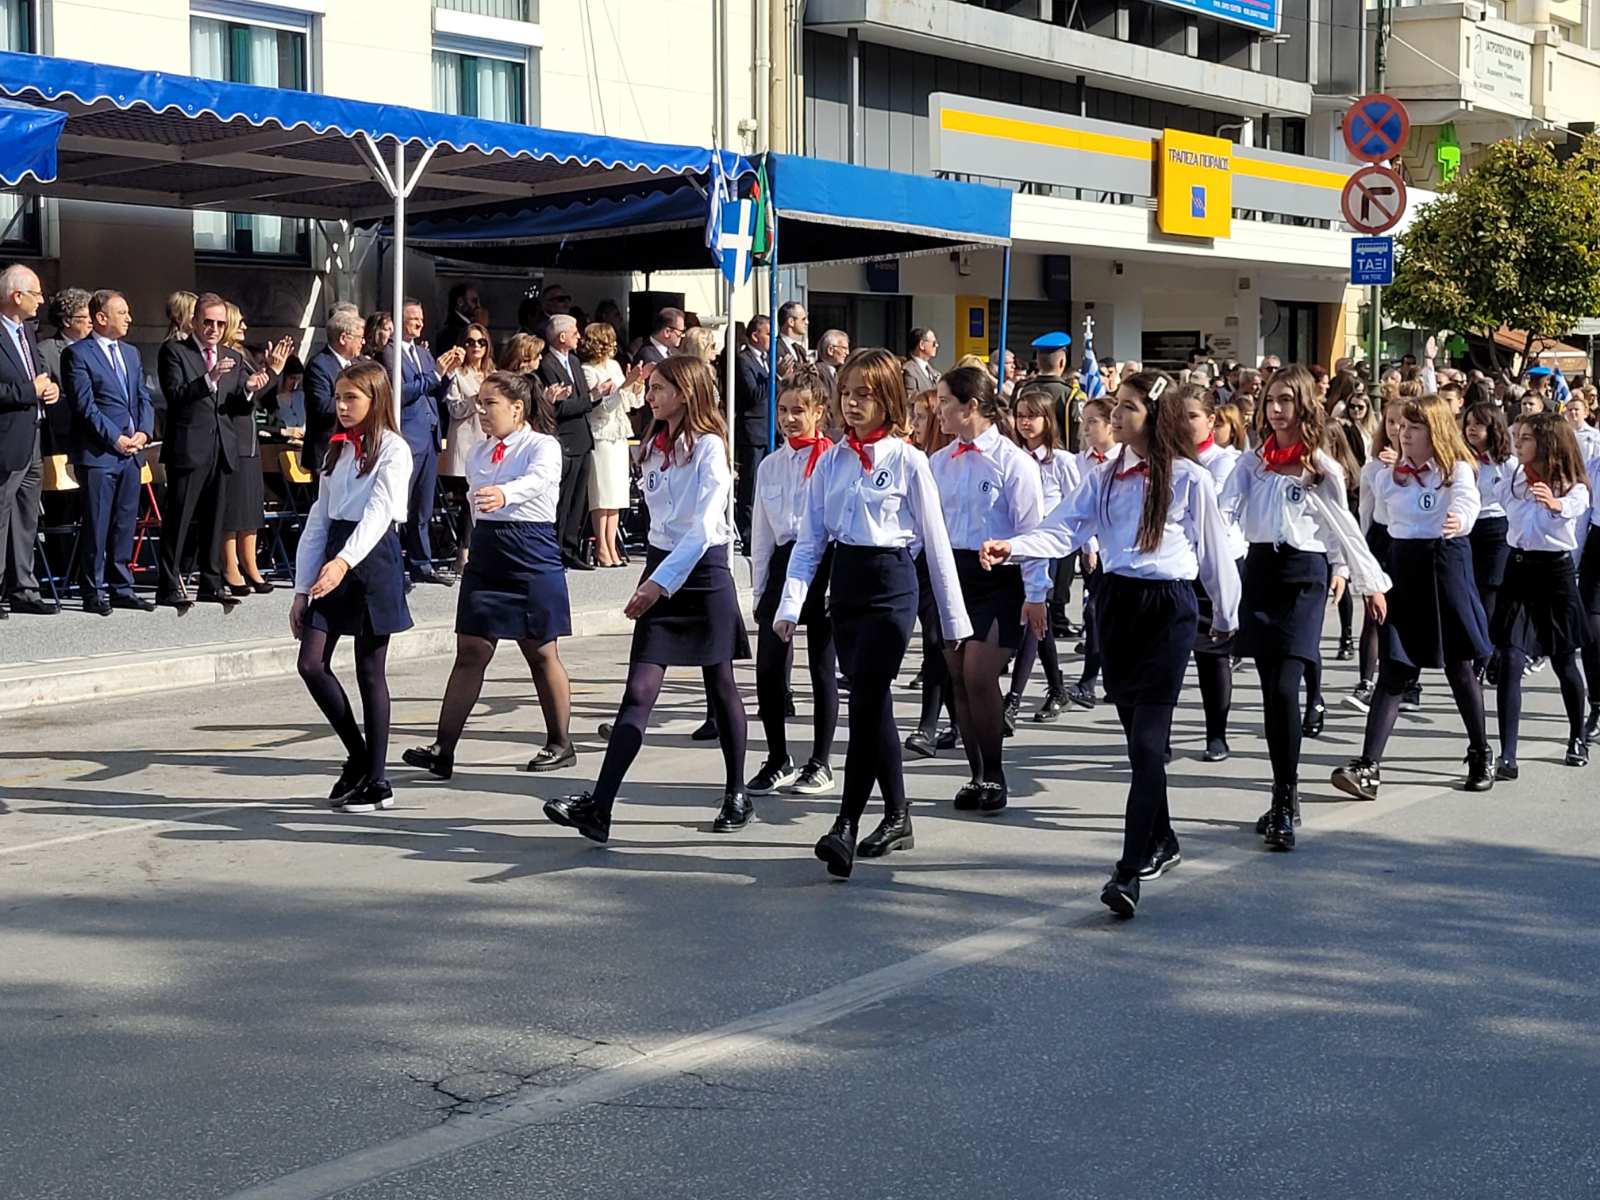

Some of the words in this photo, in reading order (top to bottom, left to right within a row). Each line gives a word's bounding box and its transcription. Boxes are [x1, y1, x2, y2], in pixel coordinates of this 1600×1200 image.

[1168, 148, 1198, 166] ΤΡΑΠΕΖΑ
[1357, 258, 1387, 270] ΤΑΞΙ
[649, 473, 654, 489] 6
[875, 471, 888, 487] 6
[982, 480, 990, 492] 6
[1291, 486, 1301, 501] 6
[1423, 494, 1431, 509] 6
